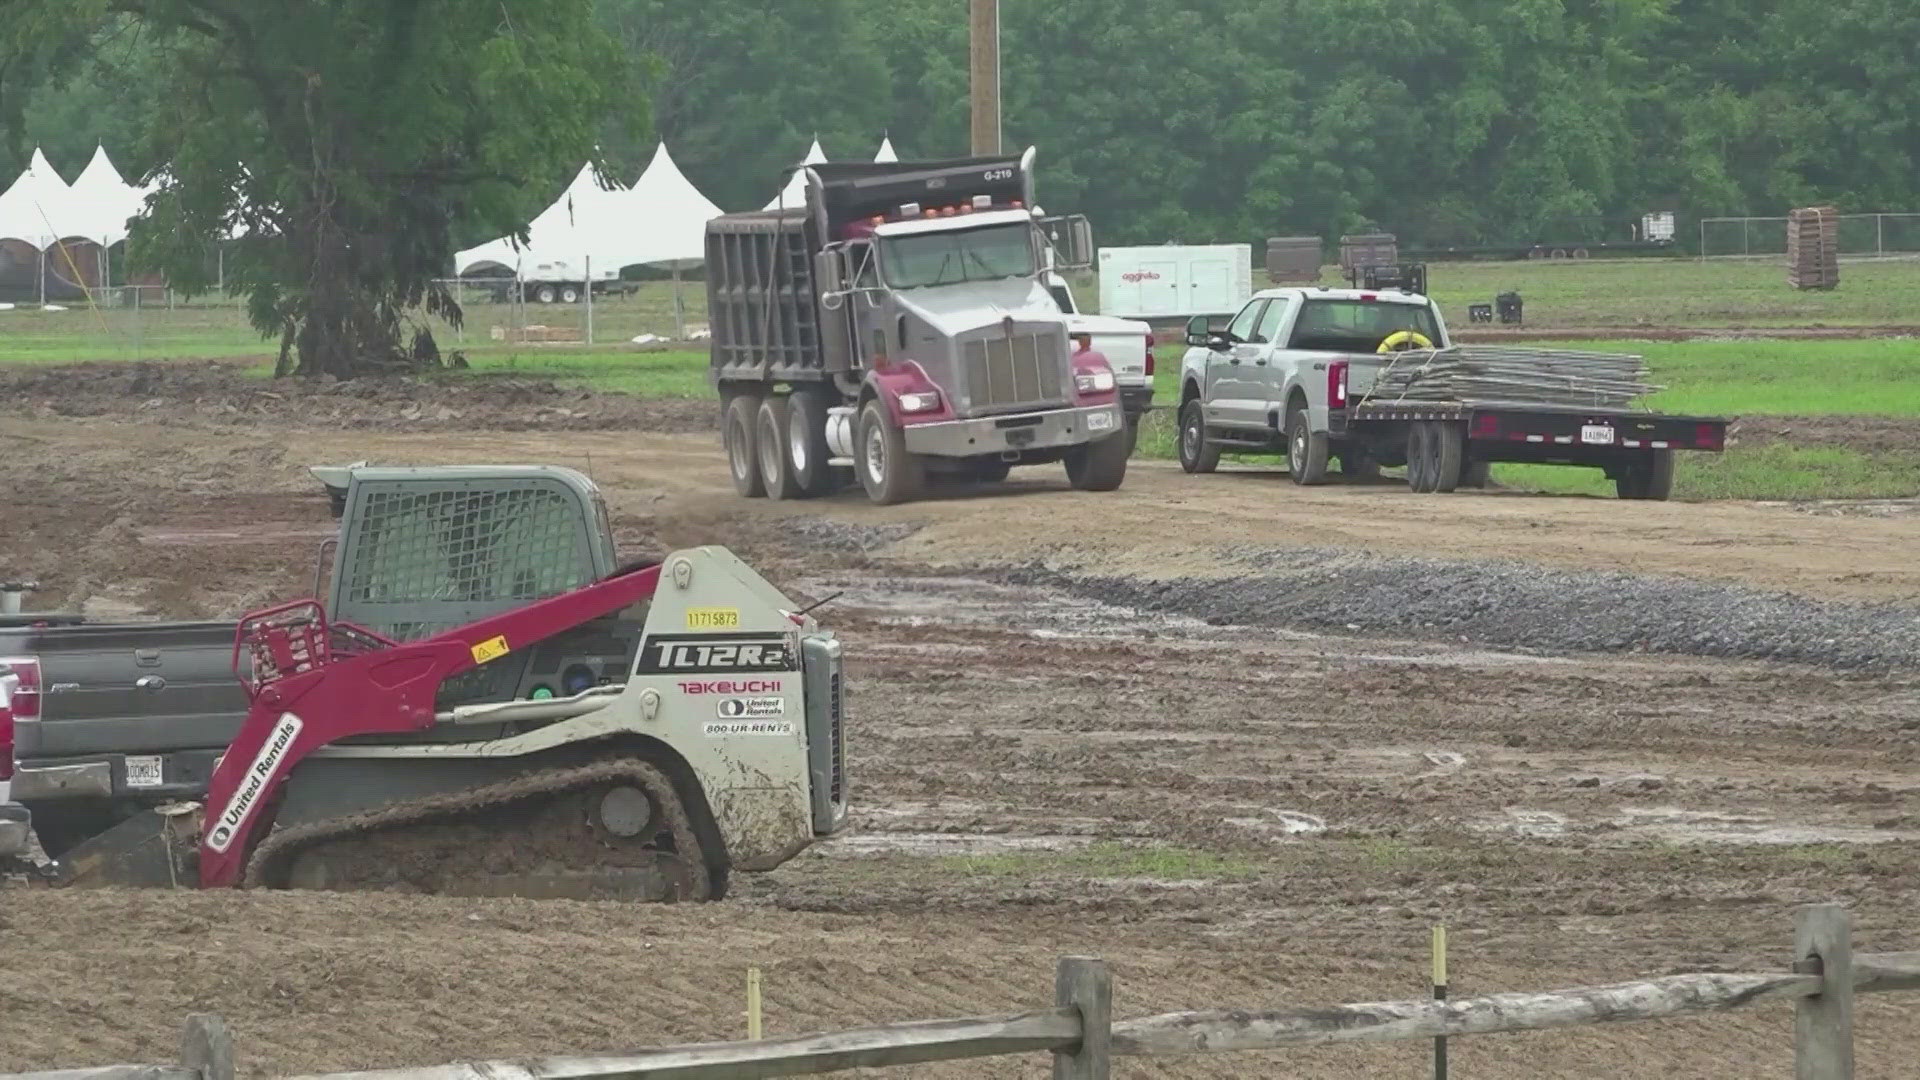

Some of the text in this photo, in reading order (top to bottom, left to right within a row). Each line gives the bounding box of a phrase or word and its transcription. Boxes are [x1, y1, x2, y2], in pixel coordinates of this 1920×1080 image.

[1122, 271, 1160, 283] aggreko
[688, 612, 738, 627] 11715873
[654, 640, 784, 668] TL12R2
[746, 699, 779, 708] United
[746, 707, 782, 716] Rentals
[225, 722, 305, 827] United Rentals
